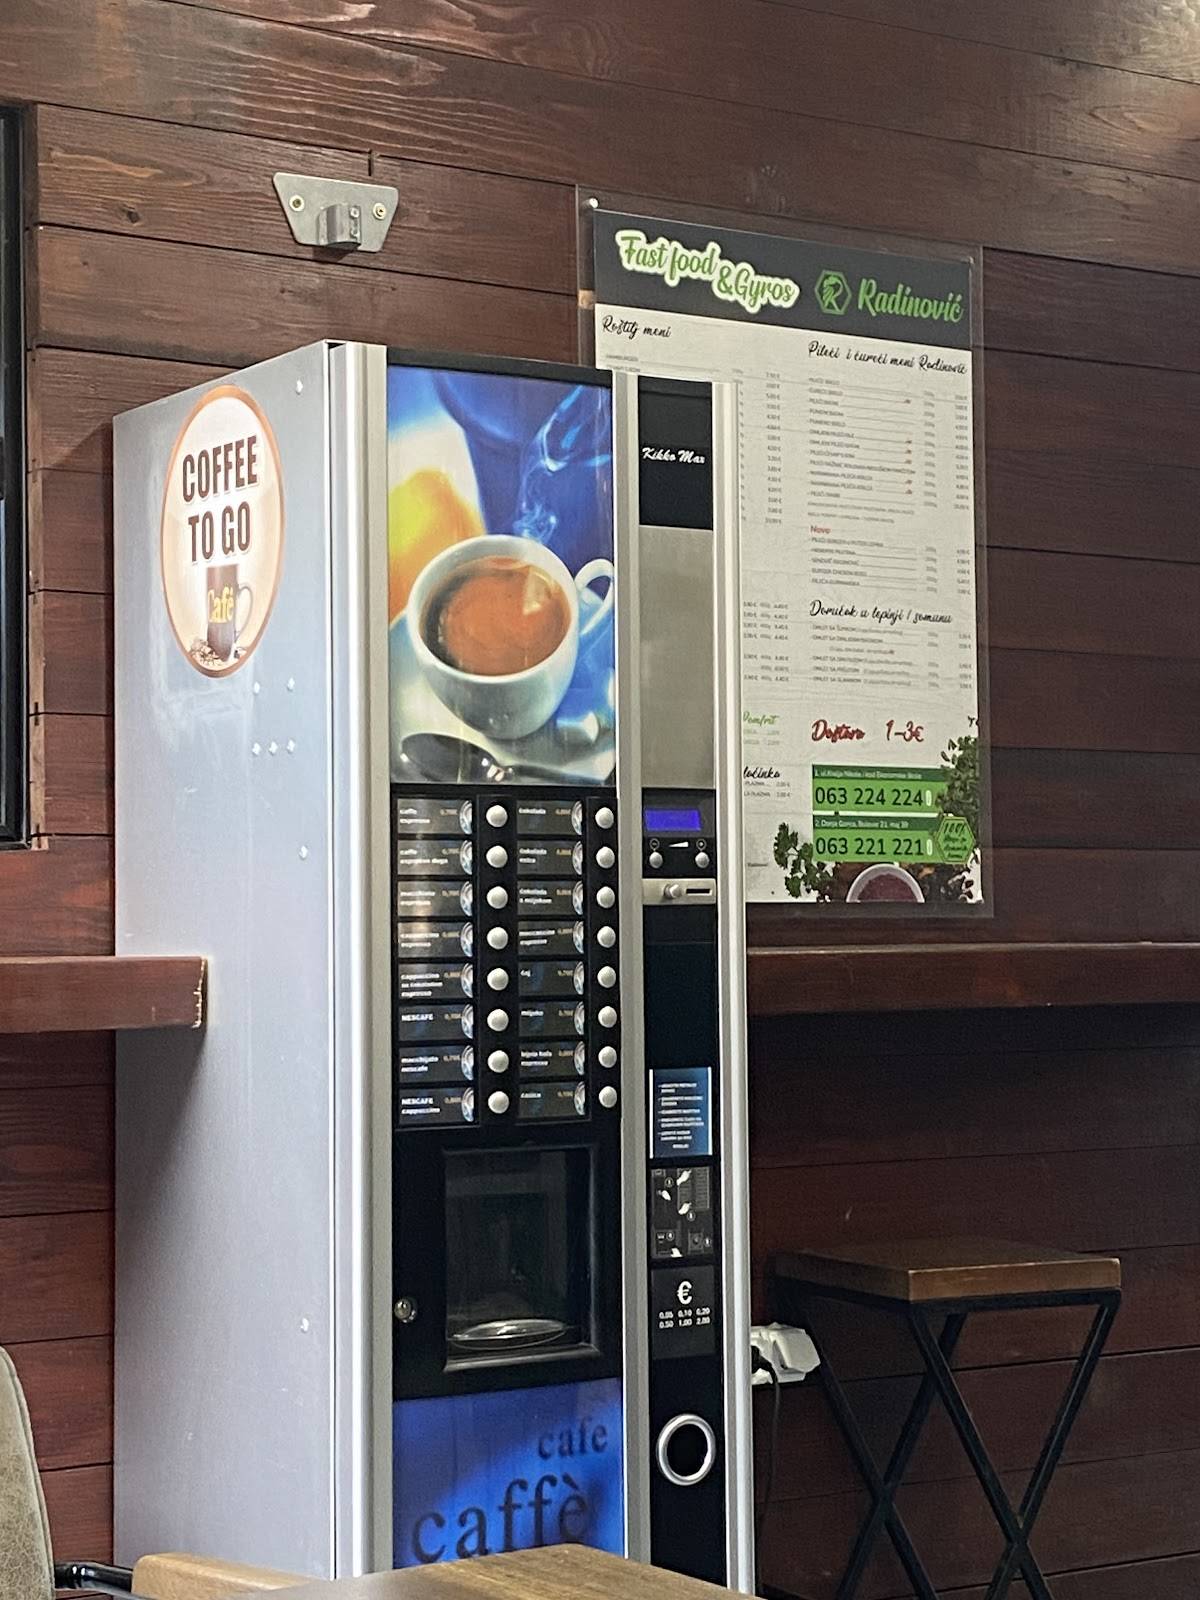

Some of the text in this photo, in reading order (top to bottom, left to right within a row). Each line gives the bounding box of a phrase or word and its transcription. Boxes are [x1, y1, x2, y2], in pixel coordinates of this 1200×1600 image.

[619, 234, 668, 270] Fast
[670, 242, 717, 281] food
[857, 277, 965, 324] Radinović
[643, 326, 672, 338] meni
[890, 356, 915, 368] meni
[642, 447, 706, 464] Kikko Max
[182, 434, 259, 503] COFFEE
[188, 501, 251, 563] TO GO
[815, 787, 923, 806] 063 224 224
[815, 837, 848, 854] 063
[855, 838, 887, 855] 221
[893, 838, 924, 856] 221
[677, 1280, 693, 1305] €
[677, 1309, 693, 1318] 0.10
[695, 1307, 711, 1316] 0.20
[658, 1320, 675, 1329] 0.50
[678, 1318, 693, 1327] 1.00
[411, 1472, 589, 1564] caffè
